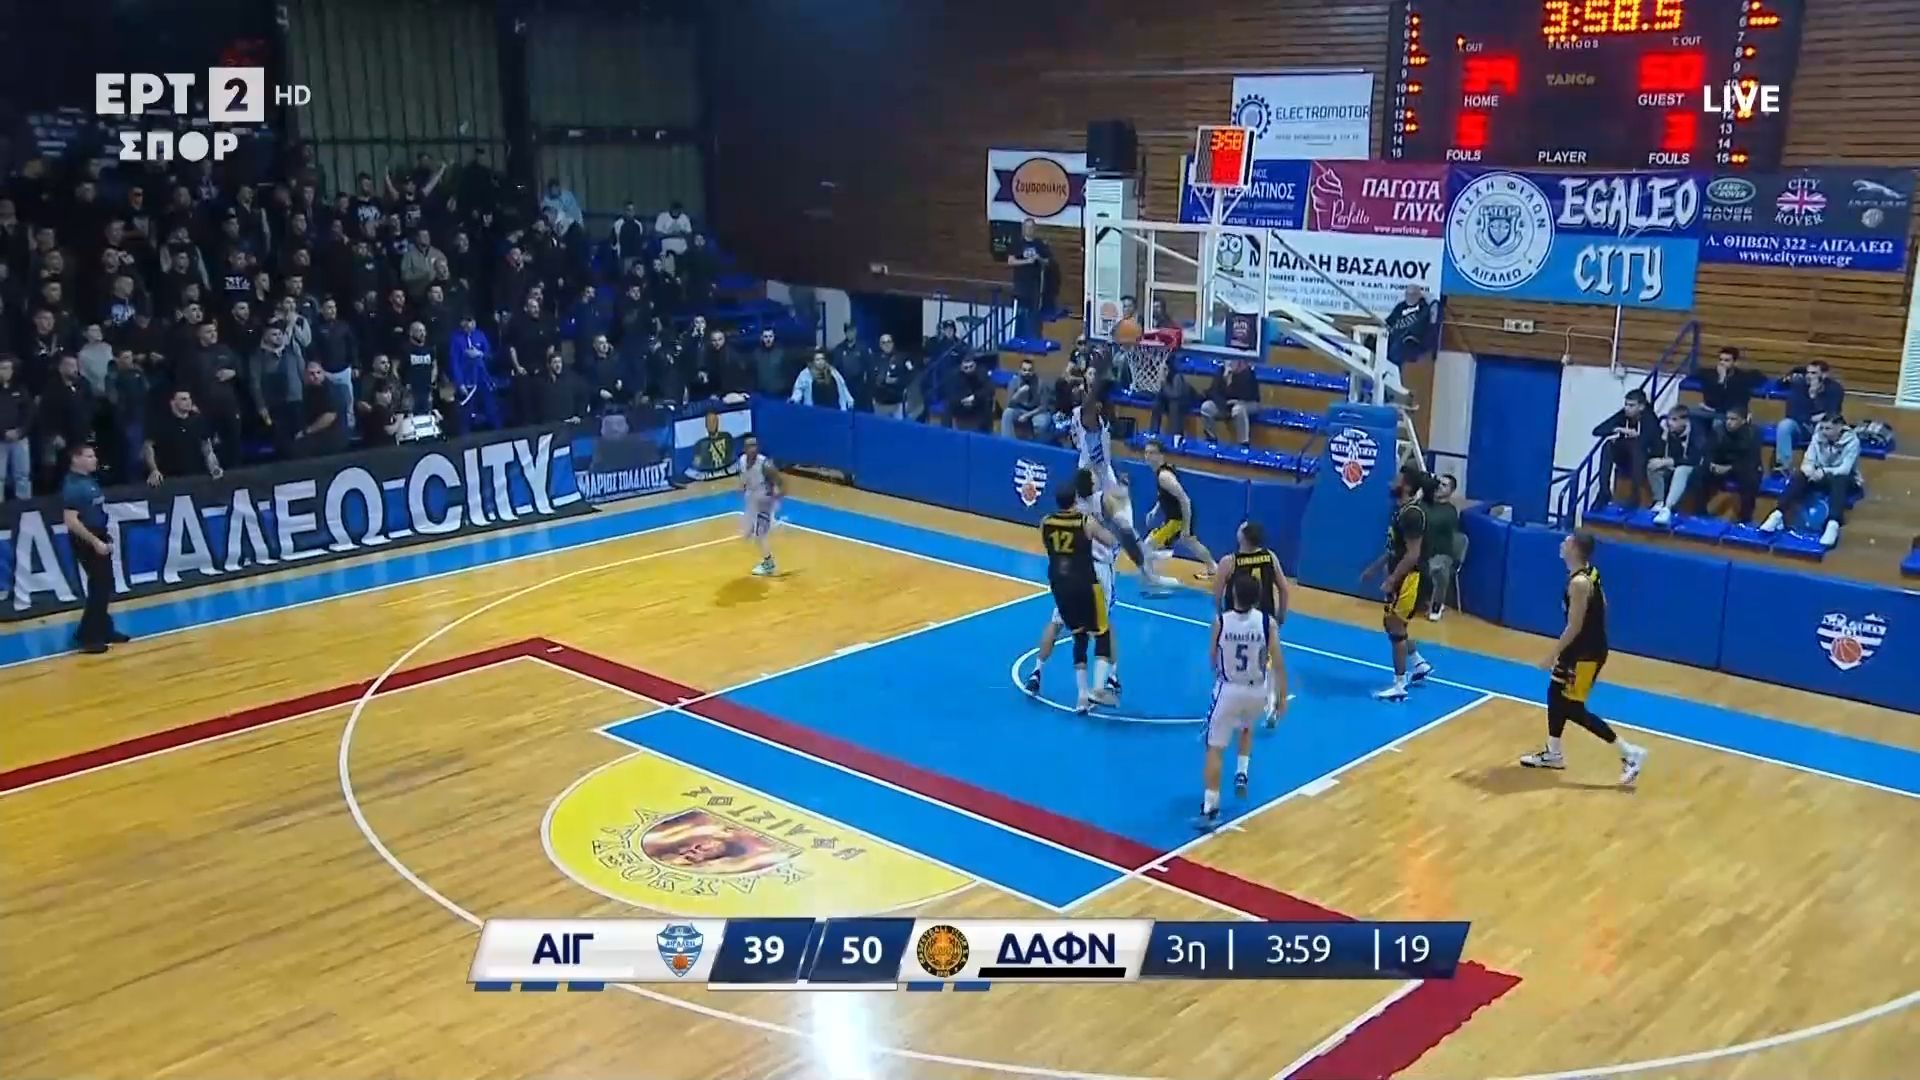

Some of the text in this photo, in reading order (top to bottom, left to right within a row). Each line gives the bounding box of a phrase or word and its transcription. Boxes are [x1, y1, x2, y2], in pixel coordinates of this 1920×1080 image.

[1464, 95, 1499, 107] HOME
[1638, 92, 1685, 106] GUEST
[1720, 124, 1733, 134] 13
[1211, 130, 1244, 151] 3:58
[1718, 138, 1730, 149] 14
[1446, 149, 1482, 162] FOULS
[1538, 151, 1588, 164] PLAYER
[1648, 152, 1691, 165] FOULS
[1716, 152, 1729, 163] 15
[1361, 178, 1441, 200] ΠΑΓΩΤΑ
[1787, 178, 1820, 190] CITY
[1392, 201, 1445, 223] ΓΛΥΚ
[1456, 180, 1546, 229] ΛΕΣΧΗ ΦΙΛΩΝ
[1557, 176, 1699, 236] EGALEO
[1775, 211, 1824, 227] ROVER
[1723, 235, 1780, 250] ΘΗΒΩΝ
[1783, 238, 1807, 250] 322
[1816, 239, 1894, 254] ΑΙΓΑΛΕΩ
[1336, 255, 1431, 280] ΒΑΣΑΛΟΥ
[1738, 250, 1853, 268] www.cityrover.gr
[1471, 266, 1521, 283] ΑΙΓΑΛΕΩ
[1573, 243, 1663, 302] CITY
[13, 466, 392, 611] ΑΓΑΛΕΩ
[1050, 529, 1075, 554] 12
[1235, 643, 1249, 672] 5
